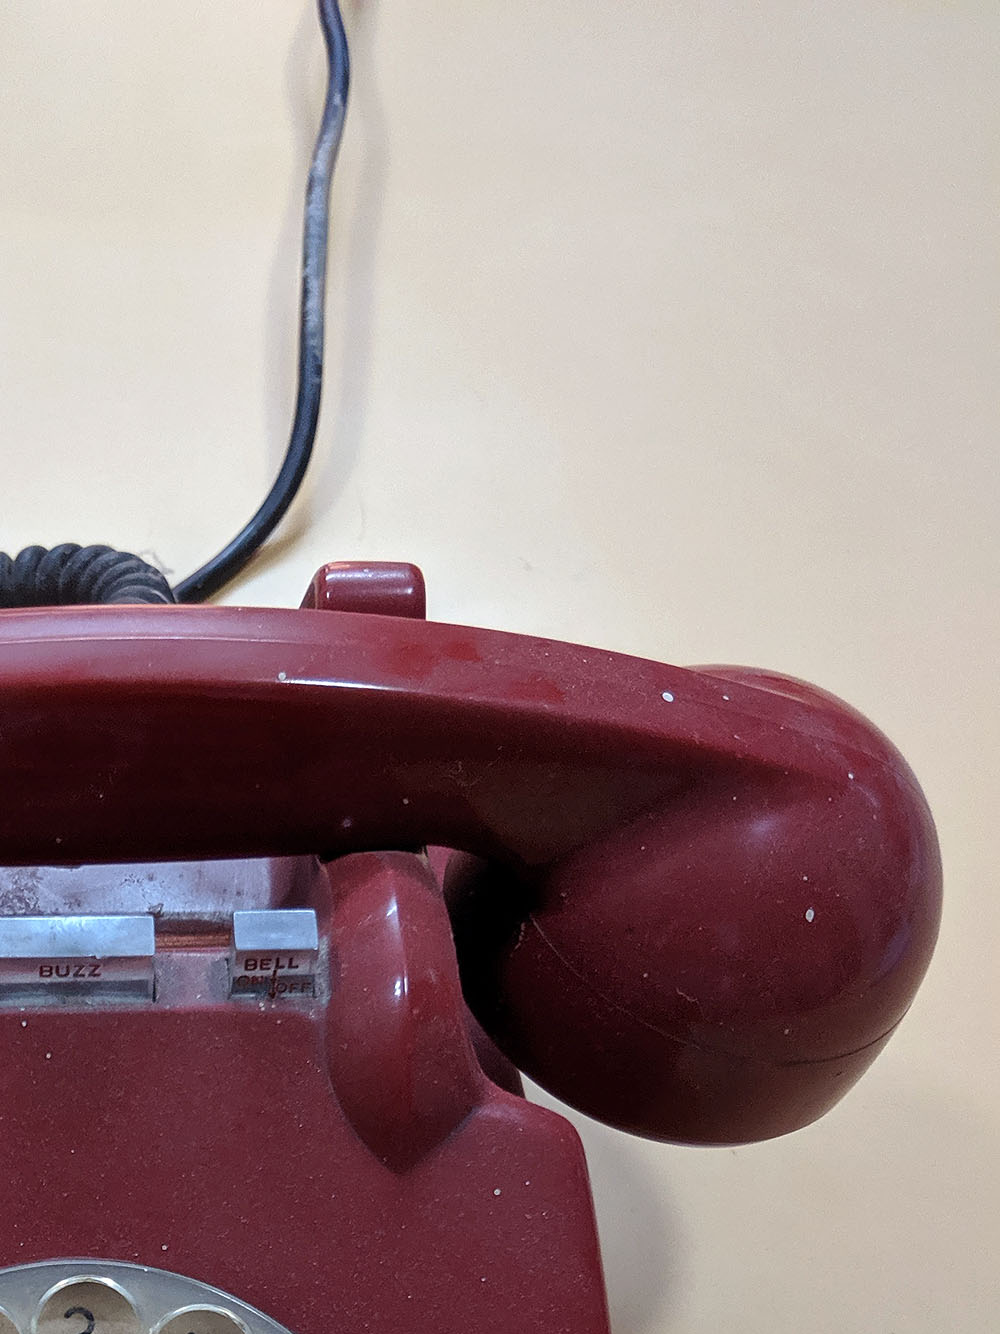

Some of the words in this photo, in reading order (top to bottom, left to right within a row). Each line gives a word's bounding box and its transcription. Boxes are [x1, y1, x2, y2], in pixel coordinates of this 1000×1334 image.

[39, 964, 102, 978] BUZZ
[244, 957, 299, 971] BELL
[276, 982, 312, 993] OFF
